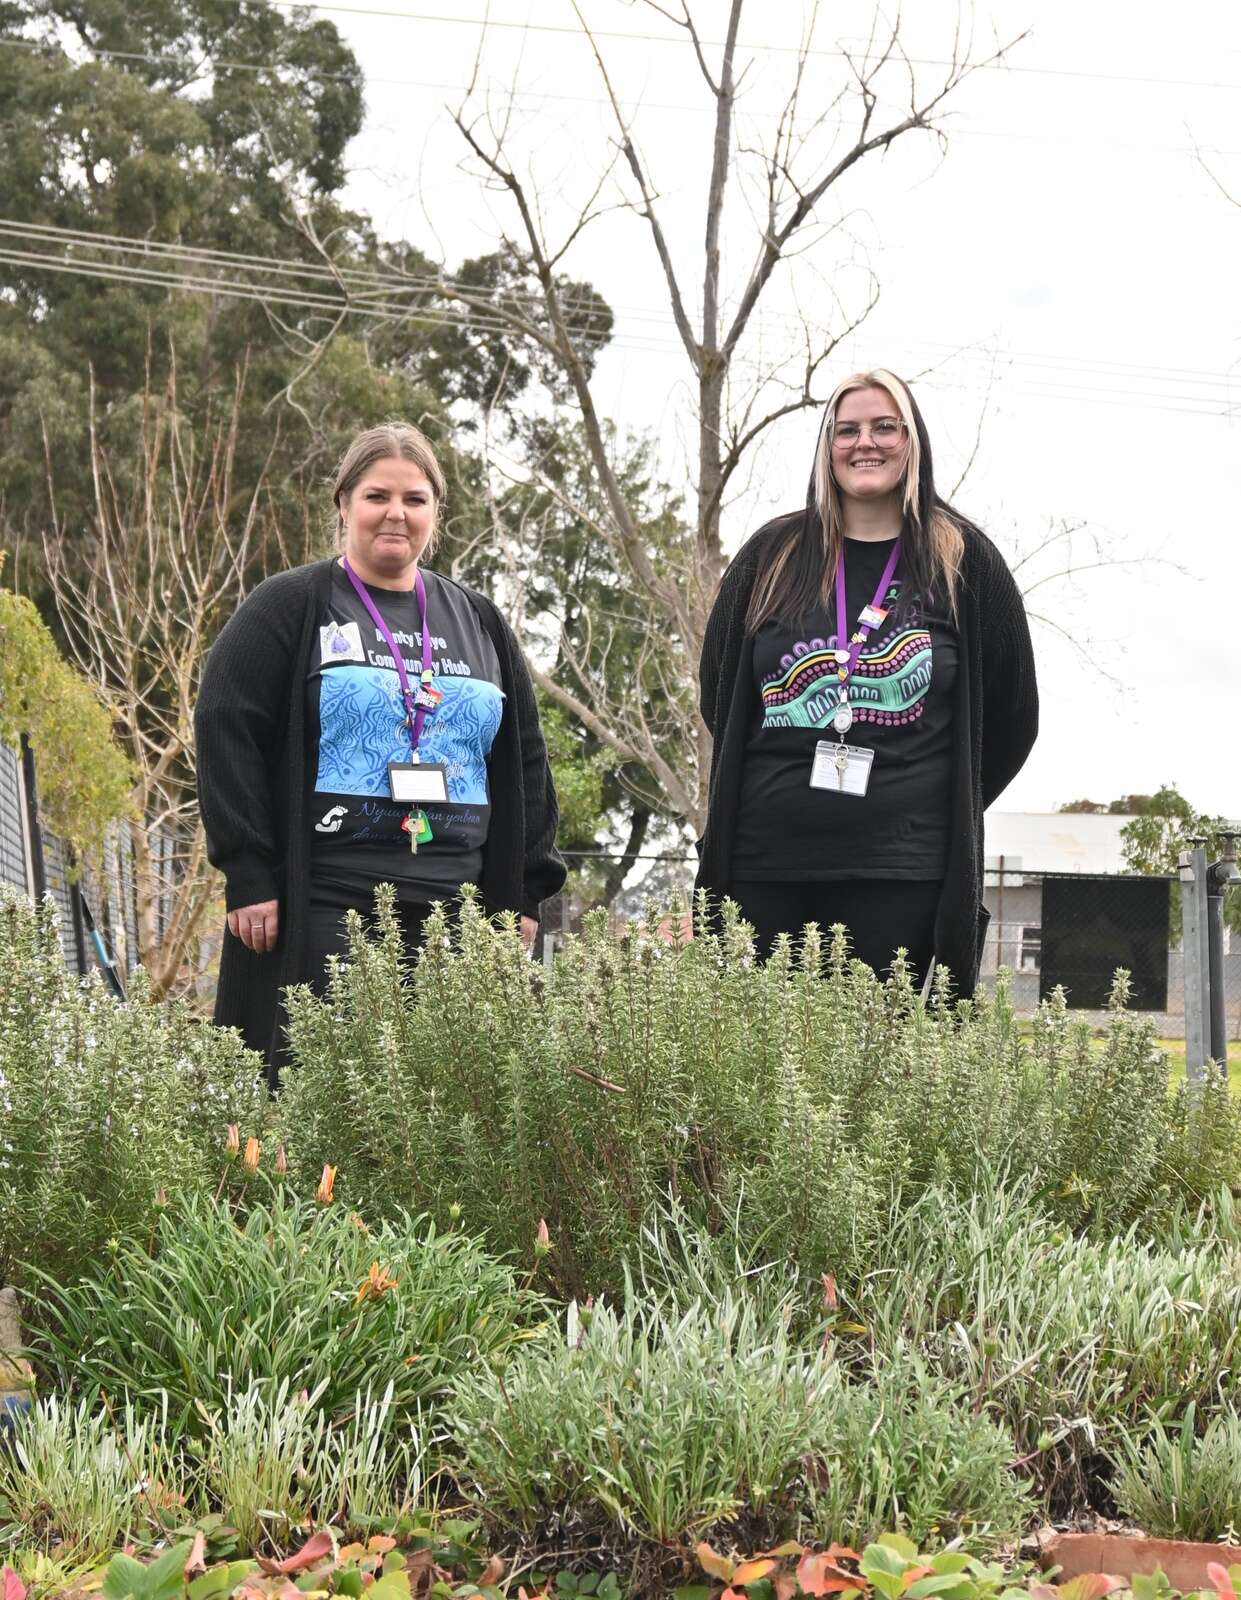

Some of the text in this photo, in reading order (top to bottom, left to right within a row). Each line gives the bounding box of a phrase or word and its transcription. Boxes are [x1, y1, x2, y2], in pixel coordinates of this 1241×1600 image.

[375, 628, 447, 650] Anty Fye
[367, 649, 471, 677] Comuny Hub
